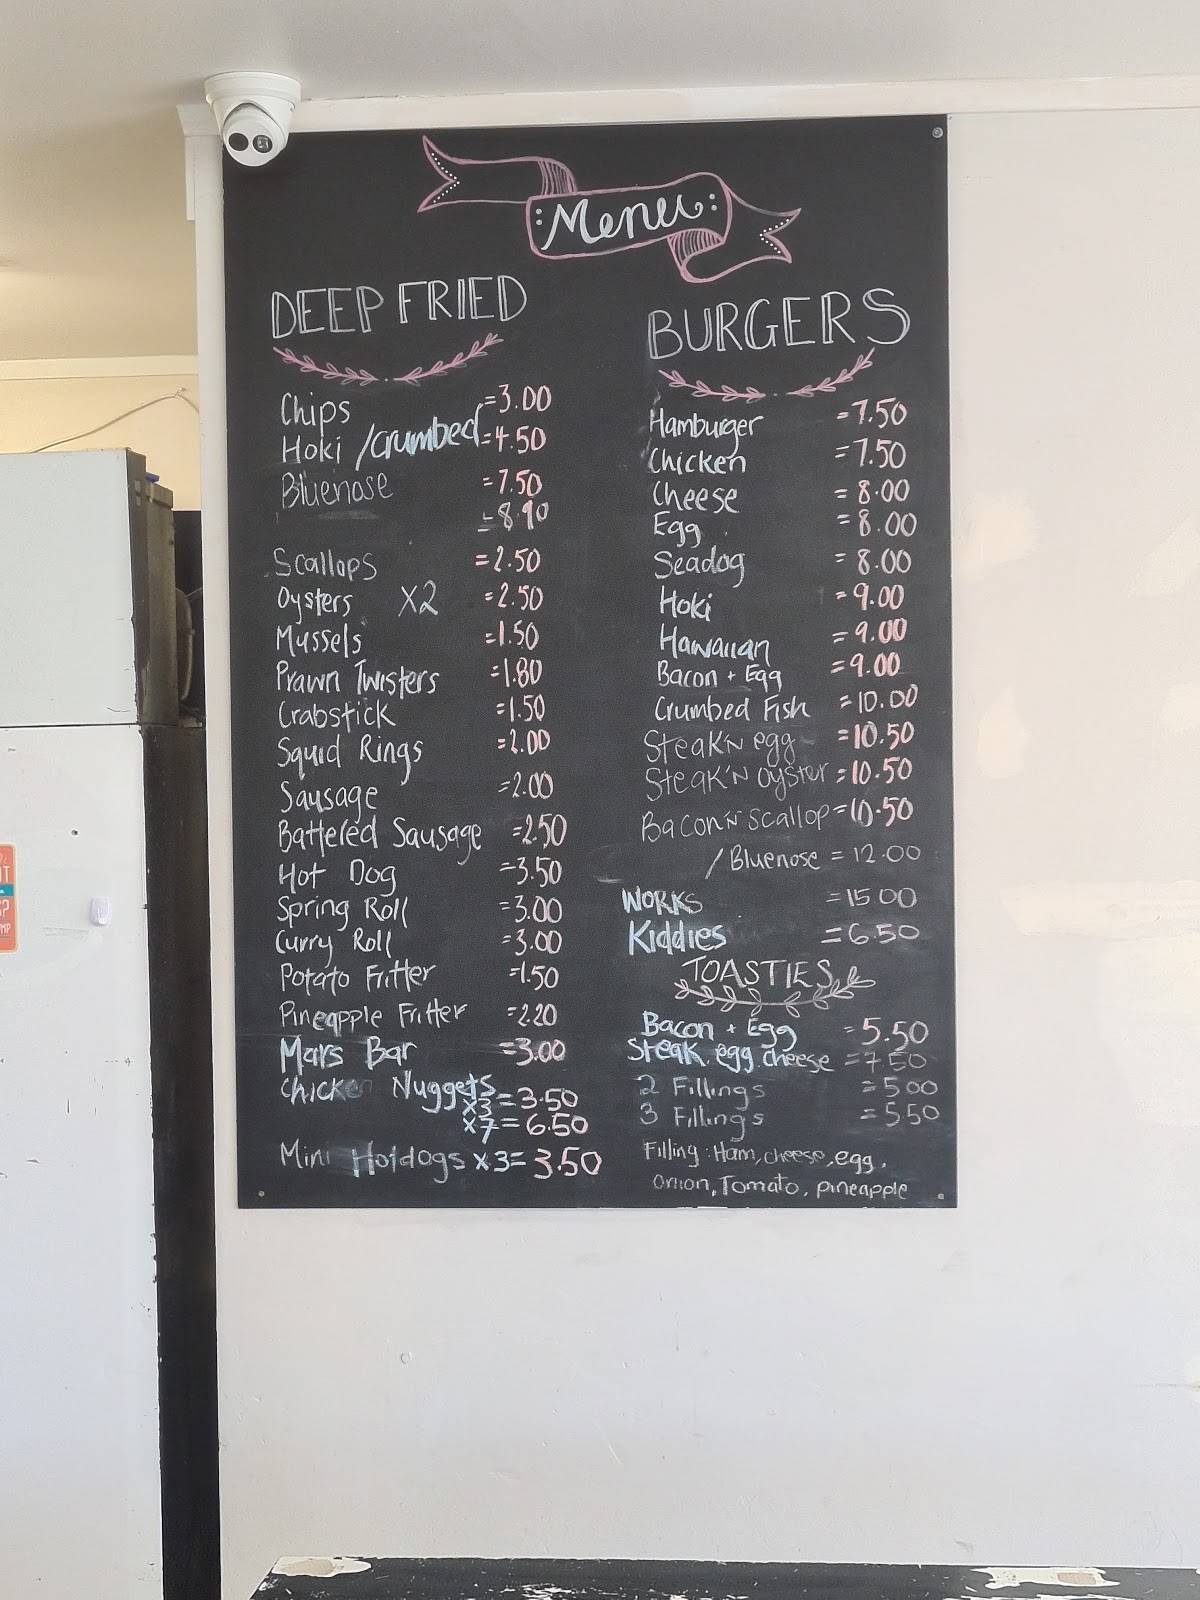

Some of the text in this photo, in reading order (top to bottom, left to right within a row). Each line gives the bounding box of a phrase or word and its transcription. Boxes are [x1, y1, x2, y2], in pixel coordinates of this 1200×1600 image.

[541, 192, 708, 251] Menu
[271, 273, 528, 339] DEEP FRIED
[648, 287, 911, 360] BURGERS
[280, 392, 351, 437] Chips
[649, 408, 765, 459] Hamburger
[282, 435, 342, 464] Hoki
[648, 447, 747, 475] Chicken
[281, 471, 394, 509] Bluenose
[653, 480, 740, 513] Cheese
[653, 510, 701, 548] Egg
[273, 547, 378, 581] Scallops
[654, 545, 746, 588] Seadog
[277, 586, 353, 625] Oysters
[660, 585, 713, 622] Hoki
[276, 622, 362, 658] Mussels
[660, 623, 770, 666] Hawaiian
[276, 659, 342, 694] Prawn
[354, 658, 441, 700] Twisters
[657, 660, 718, 688] Bacon
[745, 663, 783, 693] Egg
[278, 698, 397, 734] Crabstick
[654, 695, 751, 722] Crumbed
[763, 694, 812, 723] Fish
[277, 734, 342, 781] Squid
[360, 733, 424, 786] Rings
[753, 731, 797, 768] egg
[280, 780, 378, 823] Sausage
[392, 816, 482, 866] Sausage
[278, 862, 327, 894] Hot
[349, 858, 397, 898] Dog
[277, 895, 350, 932] Spring
[364, 896, 409, 929] Roll
[275, 929, 333, 969] Curry
[353, 926, 392, 958] Roll
[628, 919, 727, 956] Kiddies
[281, 962, 350, 996] Potato
[366, 958, 437, 993] Fritter
[681, 955, 834, 989] TOASTIES
[280, 1000, 384, 1037] Pineapple
[399, 997, 468, 1029] Fritter
[640, 1010, 714, 1040] Bacon
[747, 1018, 798, 1052] Egg
[280, 1034, 344, 1076] Mars
[365, 1035, 417, 1071] Bar
[762, 1050, 835, 1073] cheese
[392, 1070, 497, 1114] Nuggets
[636, 1074, 660, 1096] 2
[673, 1075, 766, 1111] Fillings
[640, 1101, 659, 1125] 3
[673, 1105, 765, 1142] Fillings
[280, 1137, 331, 1169] Mini
[350, 1140, 466, 1184] Hotdogs
[817, 1182, 908, 1201] pineapple
